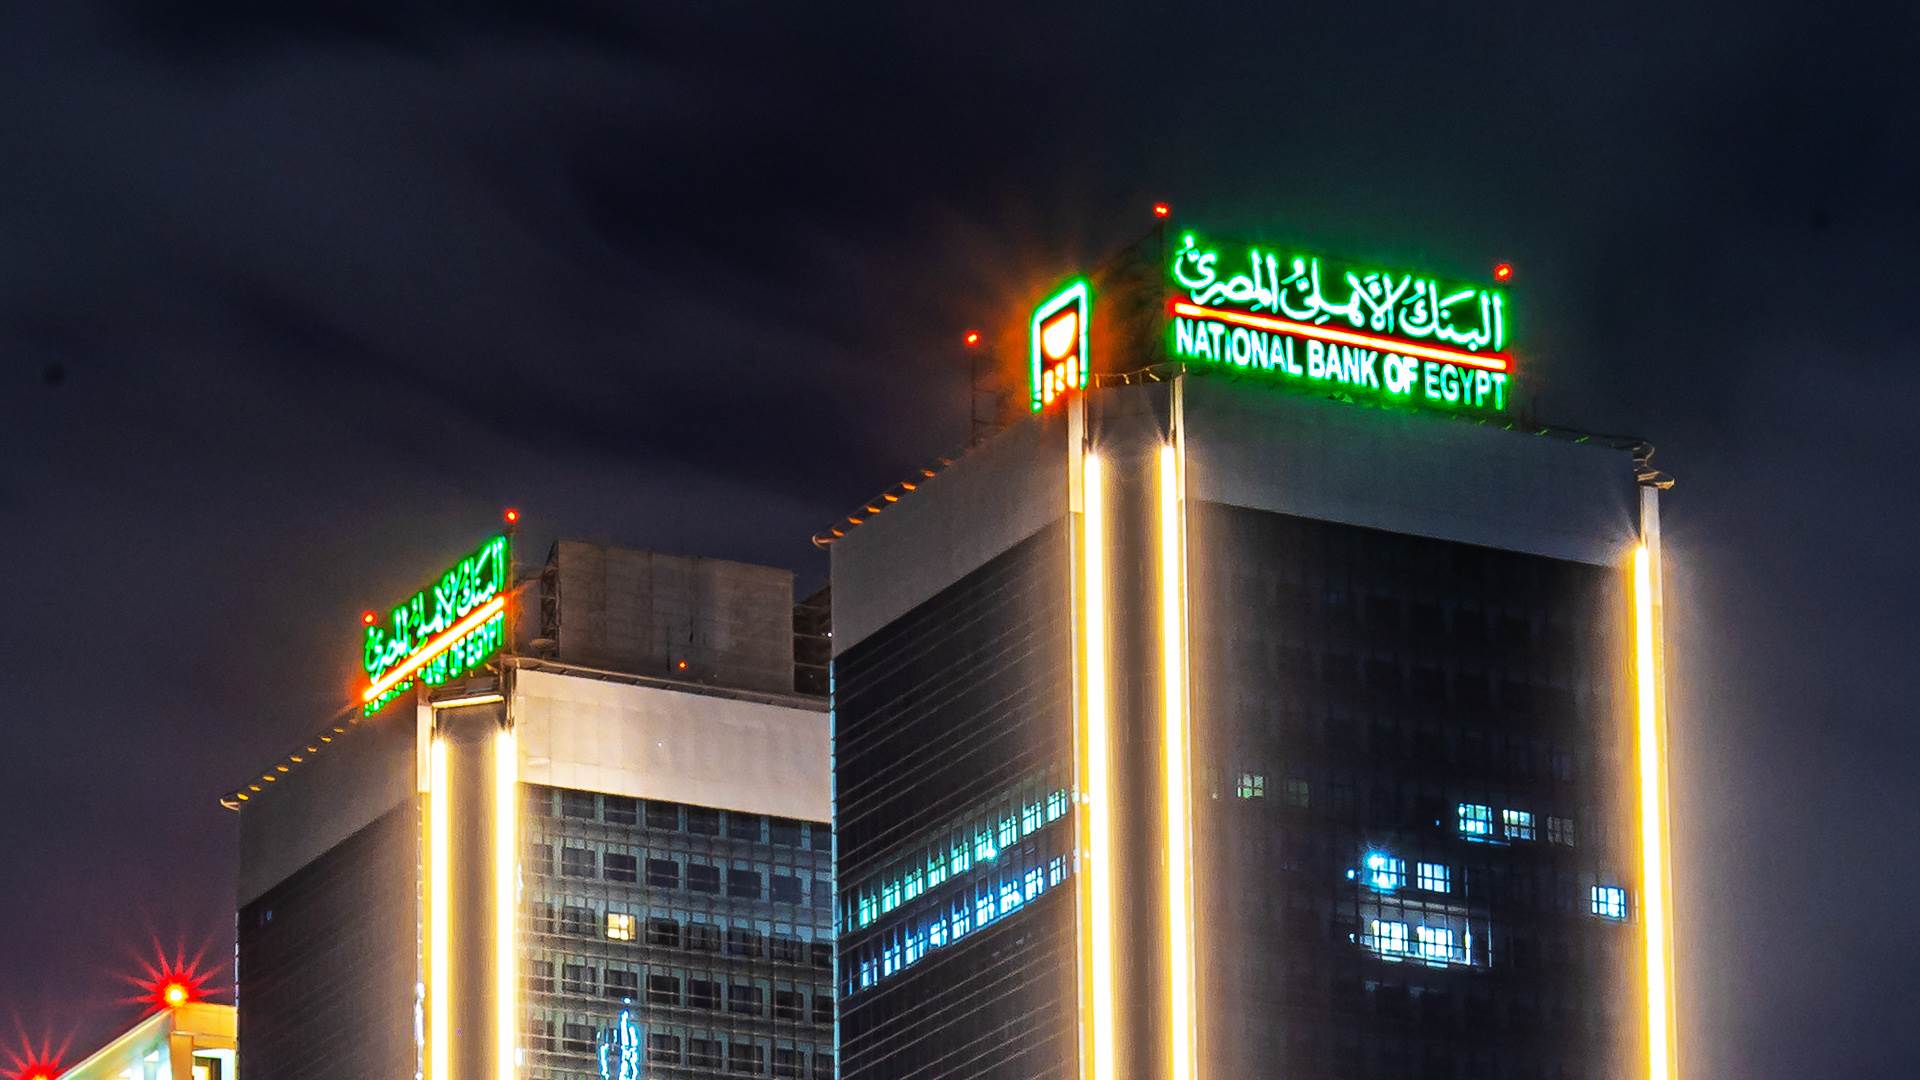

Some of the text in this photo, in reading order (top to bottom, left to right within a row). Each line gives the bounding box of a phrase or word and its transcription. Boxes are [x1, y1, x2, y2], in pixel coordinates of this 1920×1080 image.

[1175, 317, 1507, 410] NATIONAL BANK OF EGYPT
[467, 611, 505, 667] EGYPT
